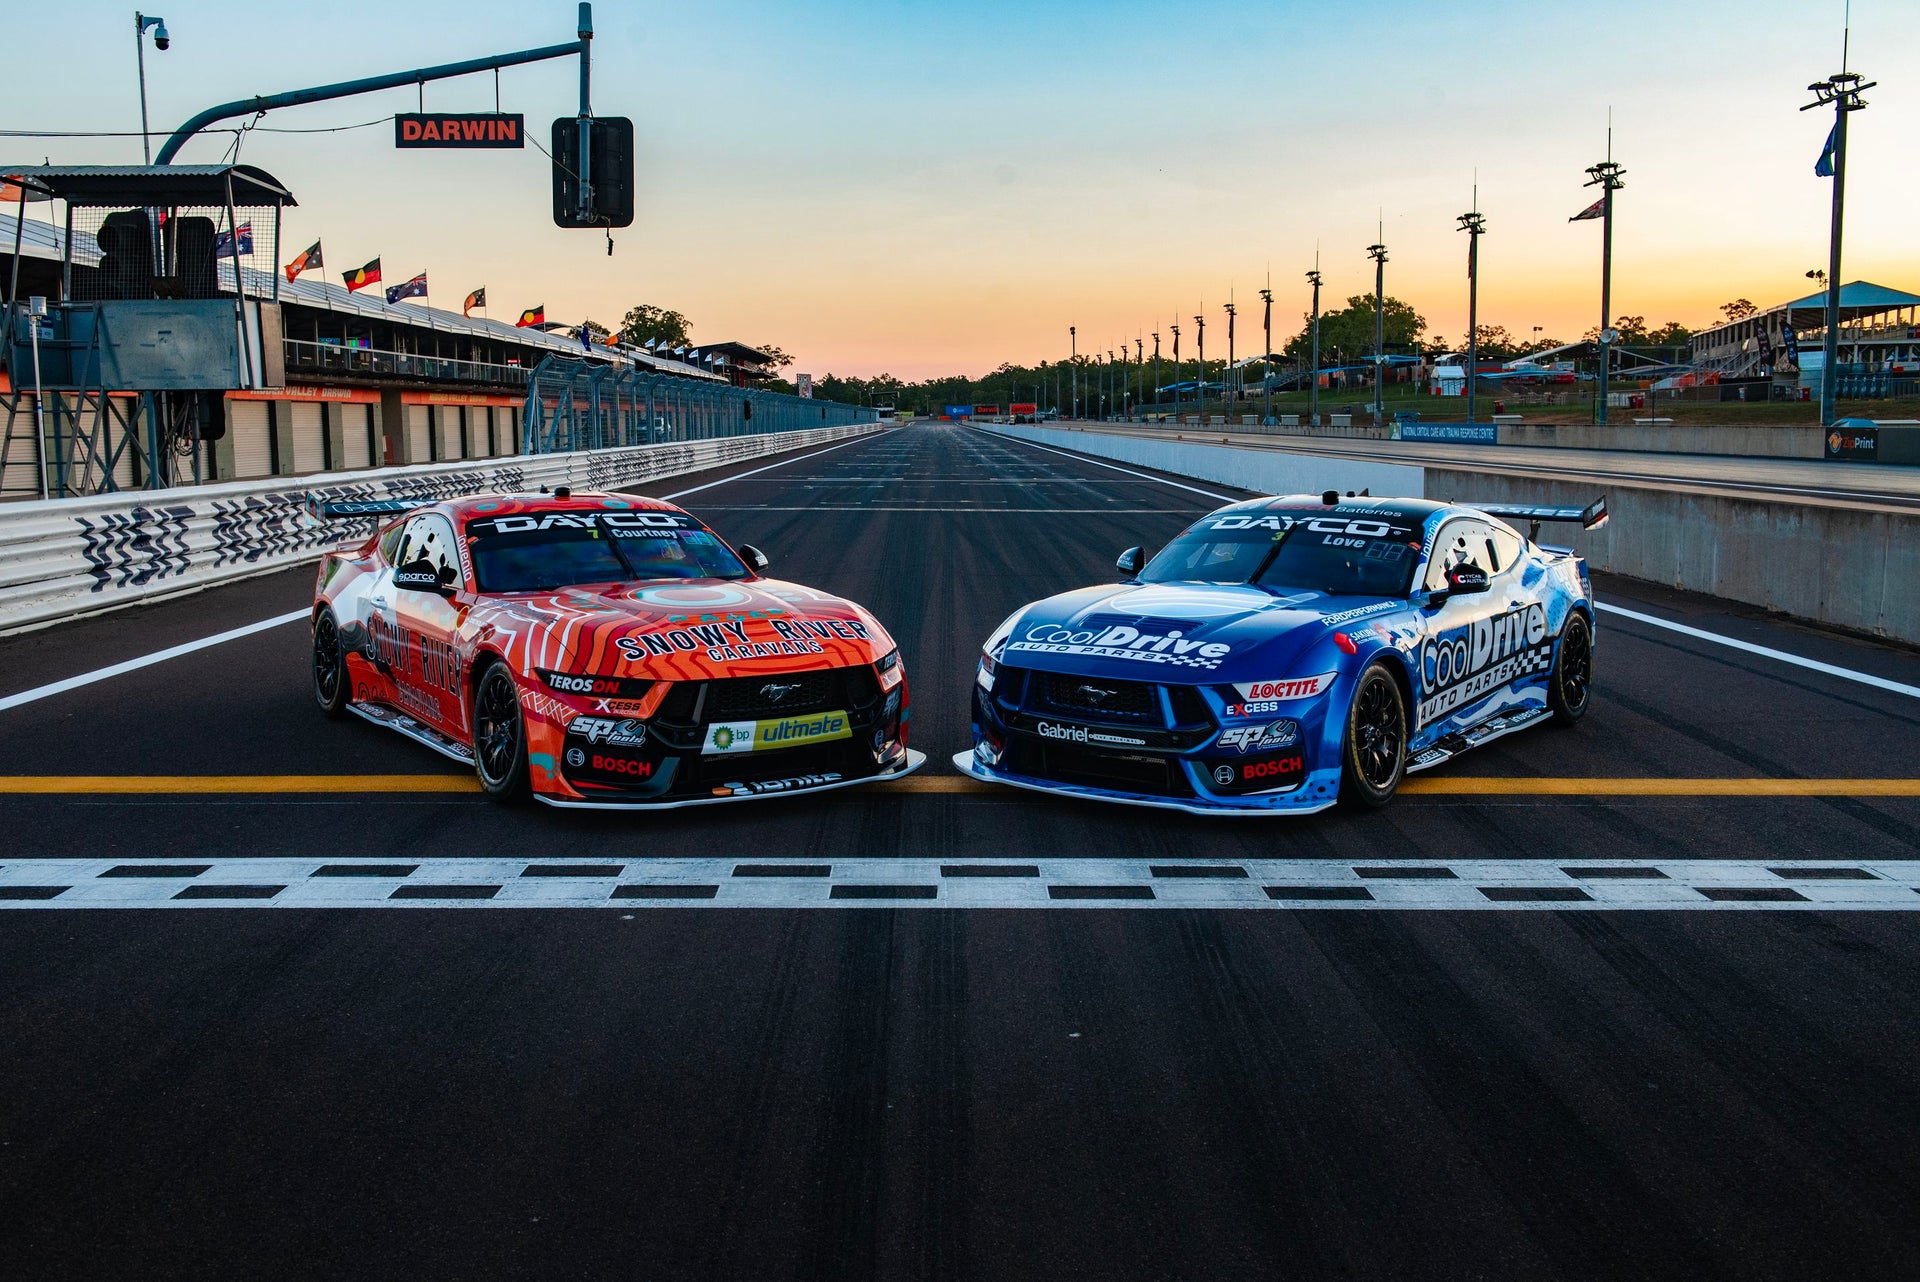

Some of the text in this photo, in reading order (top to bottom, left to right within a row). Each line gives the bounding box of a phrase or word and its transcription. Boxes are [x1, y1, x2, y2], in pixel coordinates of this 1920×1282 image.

[402, 119, 516, 141] DARWIN
[286, 386, 318, 397] VALLEY
[321, 388, 352, 399] DARWIN
[1842, 437, 1874, 449] ZipPrint
[1334, 505, 1402, 518] Batteries
[494, 513, 680, 533] DAYCO
[1210, 515, 1391, 537] DAYCO
[587, 529, 599, 539] 7
[612, 528, 678, 540] Courtney
[1271, 531, 1286, 541] 3
[1322, 534, 1366, 549] Love
[457, 534, 473, 582] invenio
[398, 572, 436, 582] sparco
[615, 618, 876, 662] SNOWY RIVER
[1025, 624, 1231, 658] CoolDrive
[1421, 604, 1546, 695] CoolDrive
[365, 615, 462, 700] SNOWY RIVER
[705, 640, 824, 662] CARAVANS
[1014, 642, 1156, 660] AUTO PARTS
[549, 673, 620, 694] TEROSON
[1249, 678, 1319, 699] LOCTITE
[1420, 663, 1509, 721] AUTO PARTS
[590, 698, 641, 714] EXCESS
[1226, 701, 1279, 718] EXCESS
[570, 716, 645, 743] SP tools
[736, 729, 750, 741] bp
[763, 715, 843, 742] ultimate
[1037, 721, 1088, 743] Gabriel
[1219, 726, 1296, 752] SP tools
[592, 754, 652, 776] BOSCH
[1242, 756, 1302, 780] BOSCH
